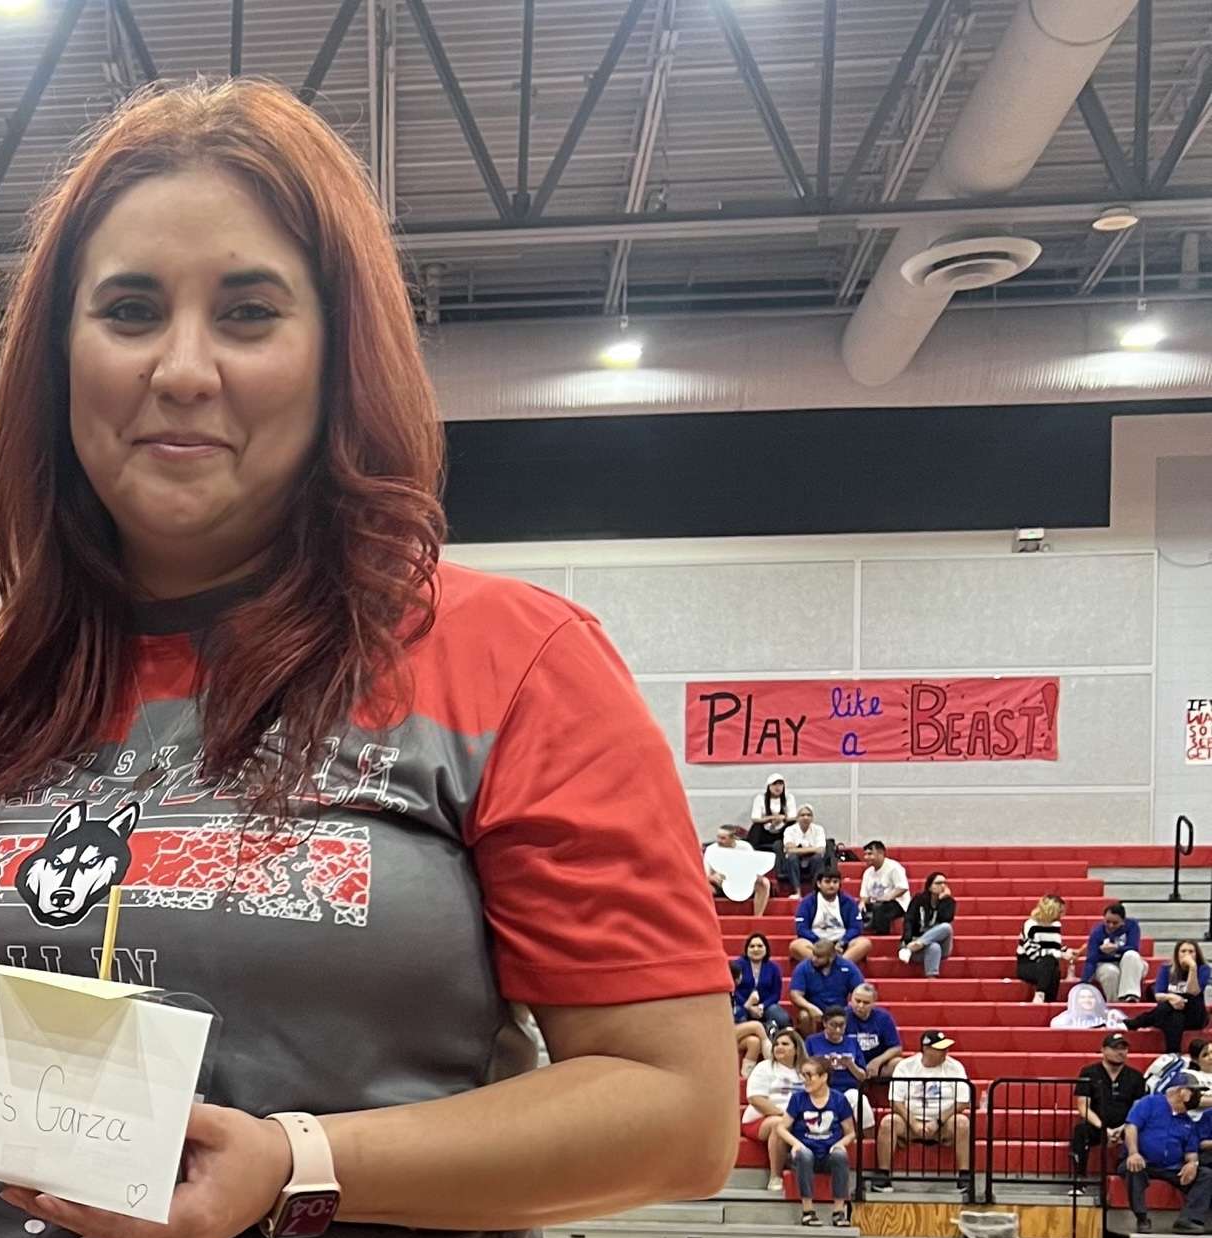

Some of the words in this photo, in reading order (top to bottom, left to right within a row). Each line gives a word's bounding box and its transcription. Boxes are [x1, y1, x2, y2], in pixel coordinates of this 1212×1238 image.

[828, 687, 884, 720] like
[909, 682, 1060, 757] BEAST!
[841, 731, 868, 757] a
[36, 1063, 132, 1143] Garza
